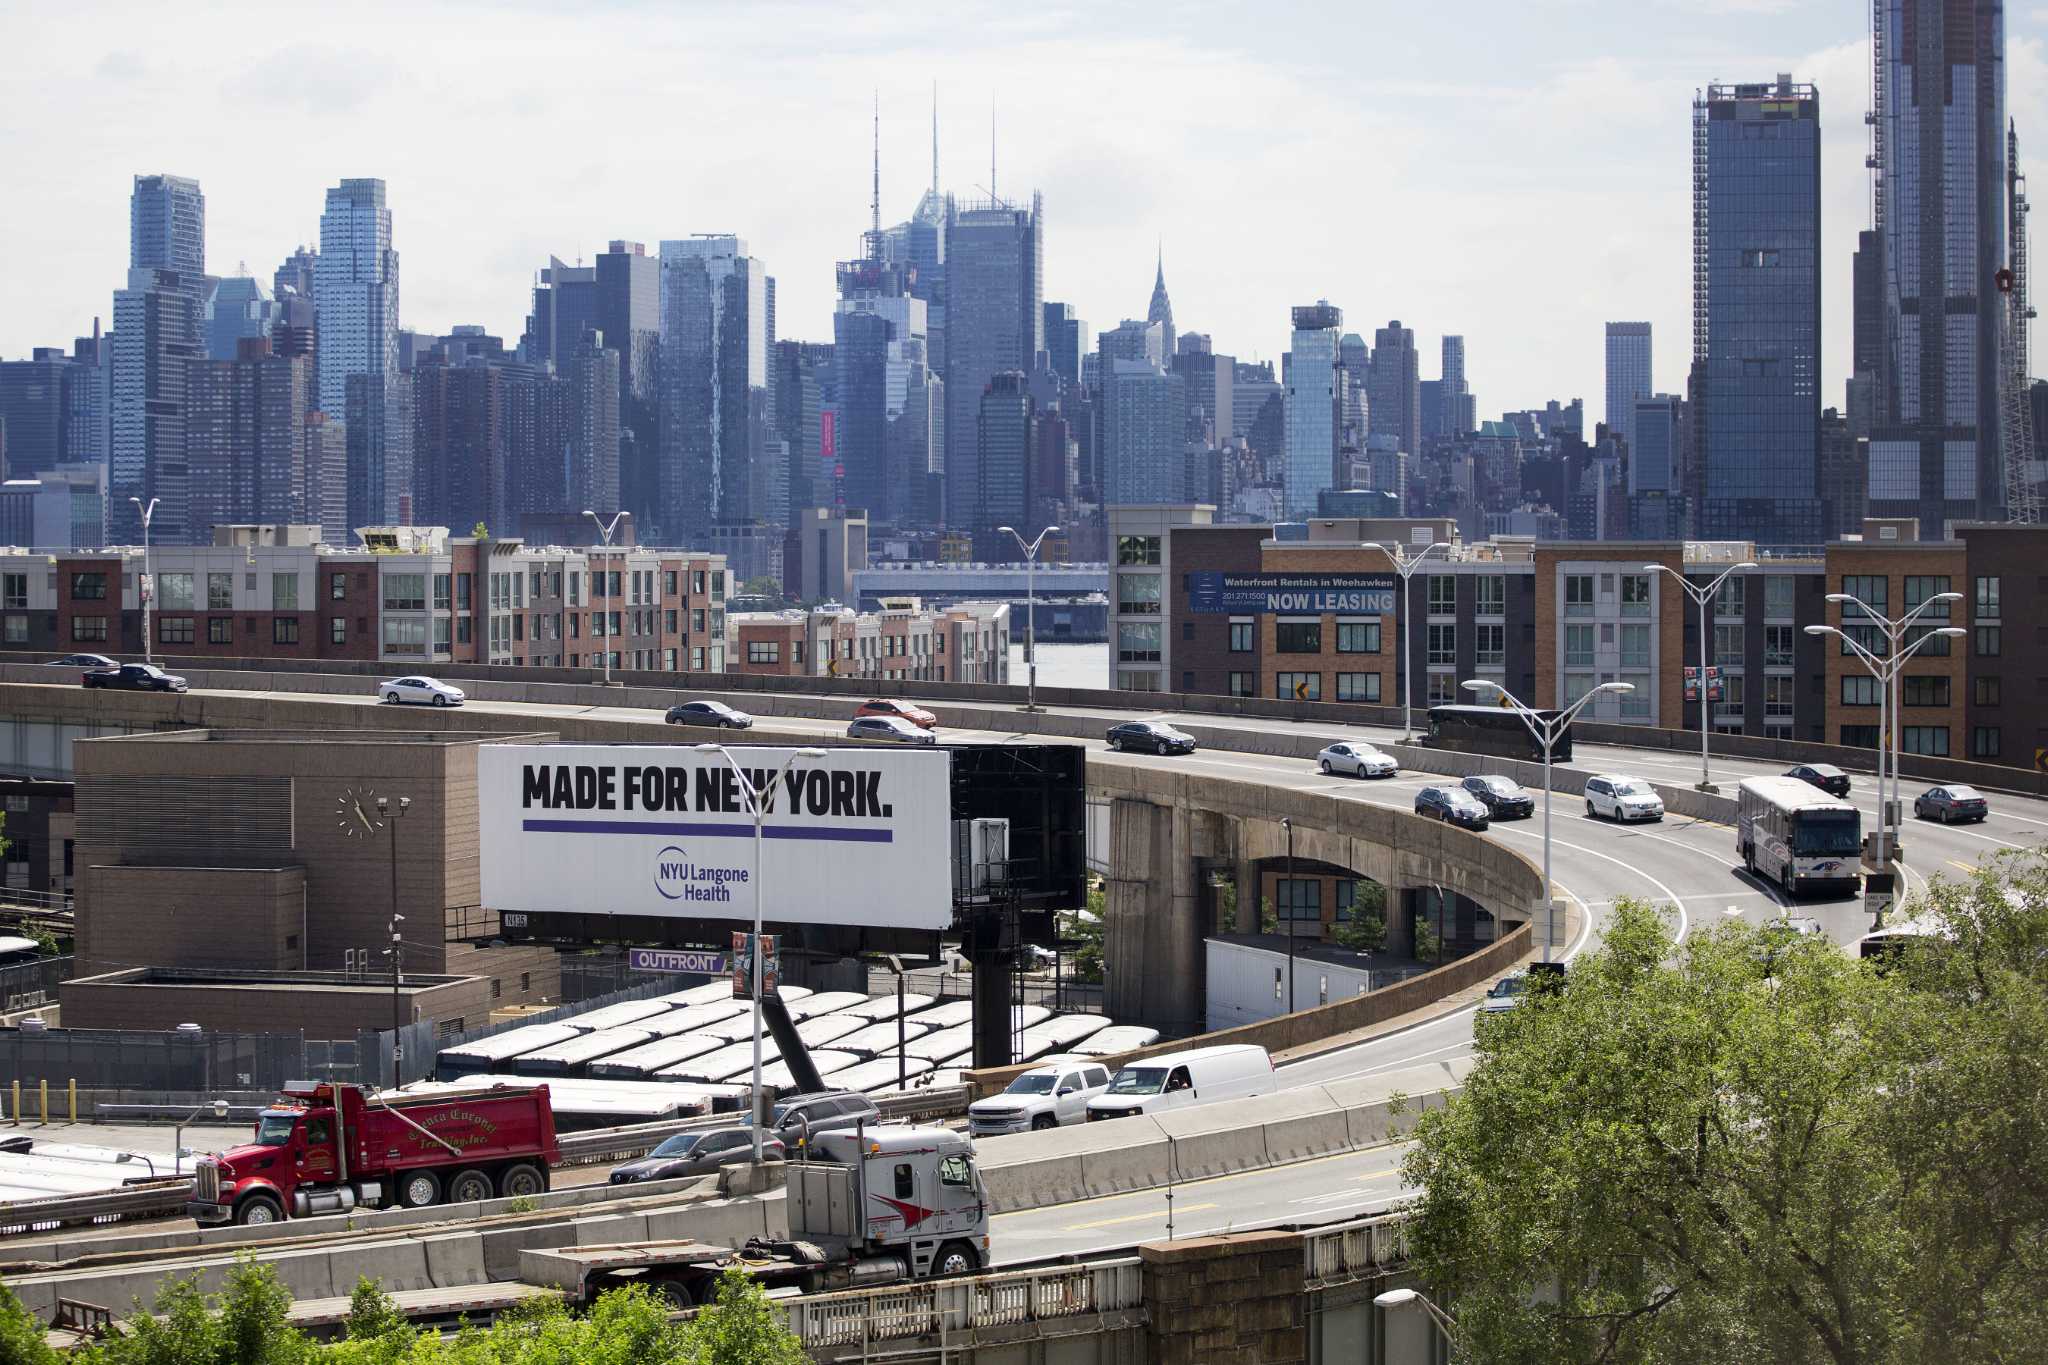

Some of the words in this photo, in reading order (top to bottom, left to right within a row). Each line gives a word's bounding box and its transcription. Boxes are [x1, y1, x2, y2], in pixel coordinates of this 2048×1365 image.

[1224, 577, 1278, 587] Waterfront
[1280, 578, 1318, 587] Rentals
[1320, 578, 1330, 587] in
[1332, 578, 1393, 587] Weehawken
[1266, 593, 1309, 610] NOW
[1314, 593, 1393, 610] LEASING
[522, 764, 617, 810] MADE
[623, 765, 689, 812] FOR
[695, 767, 777, 815] NEW
[783, 769, 893, 818] YORK.
[660, 862, 689, 881] NYU
[690, 863, 750, 886] Langone
[684, 883, 731, 902] Health
[639, 951, 718, 971] OUTFRONT
